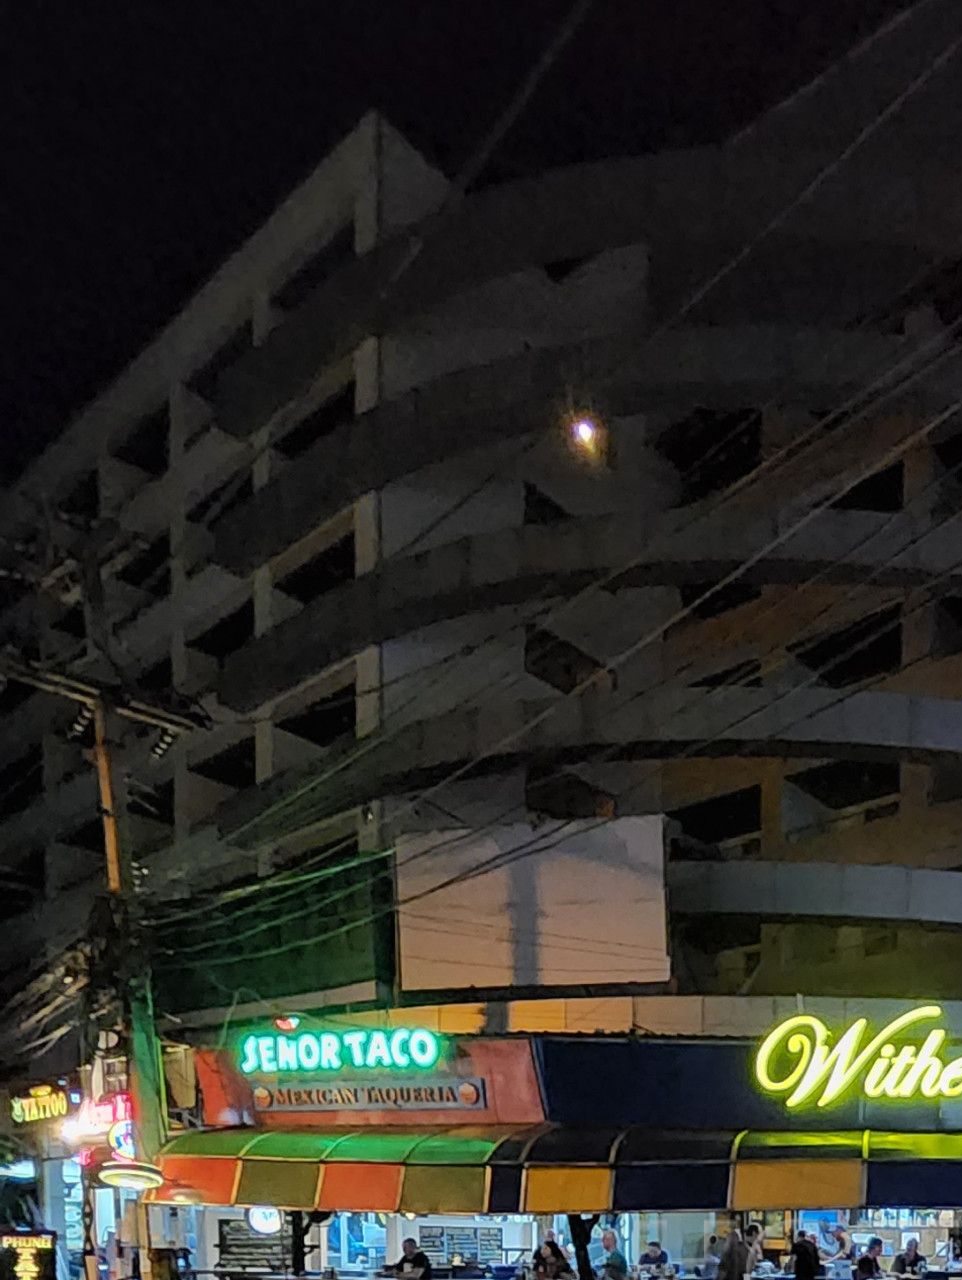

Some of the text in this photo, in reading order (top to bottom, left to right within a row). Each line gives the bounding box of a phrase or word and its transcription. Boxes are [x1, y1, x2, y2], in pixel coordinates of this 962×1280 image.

[344, 1028, 438, 1067] TACO
[21, 1091, 68, 1121] TATTOO
[274, 1085, 457, 1108] MEXICAN TAQUERIA
